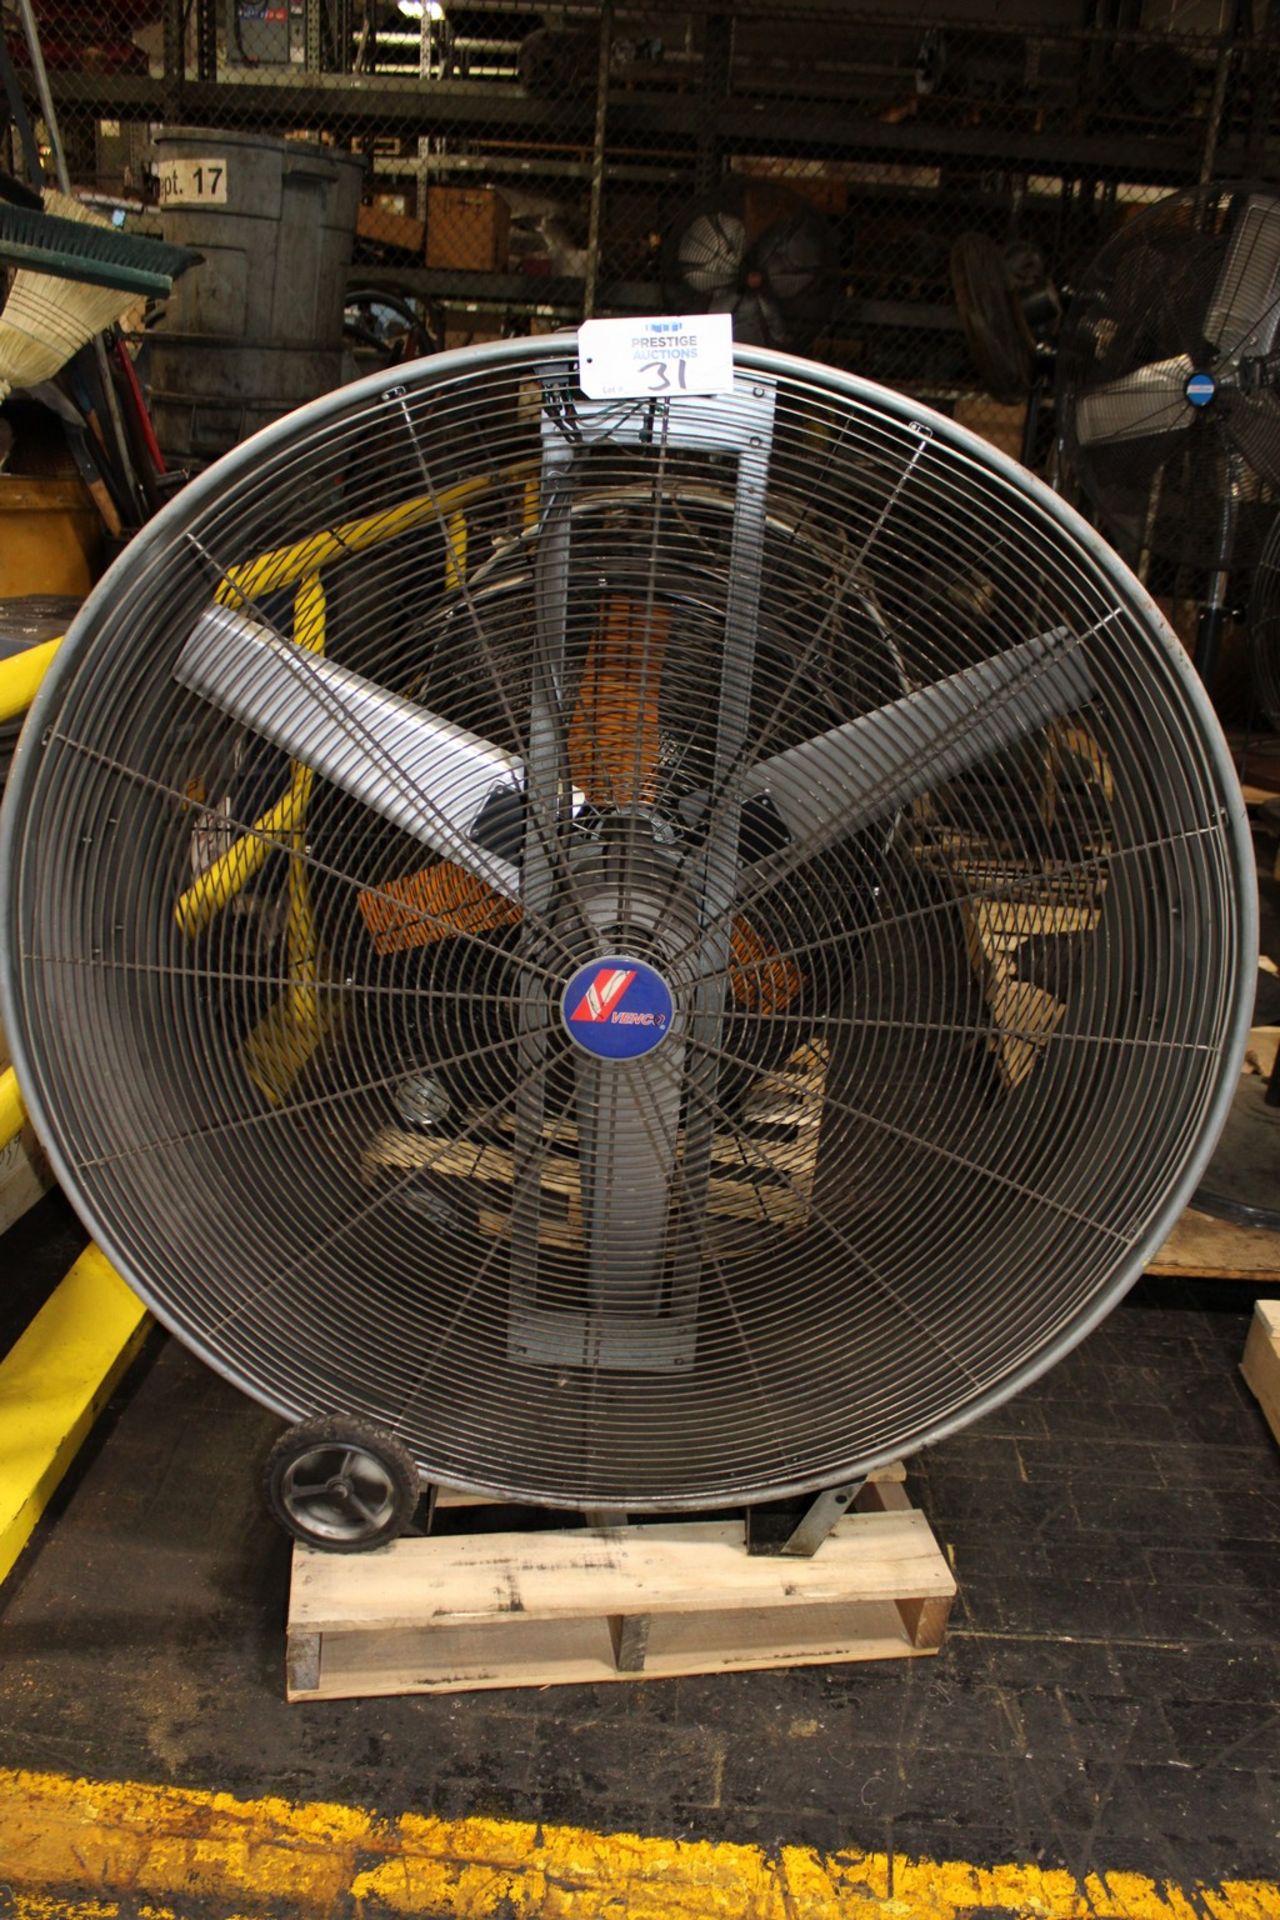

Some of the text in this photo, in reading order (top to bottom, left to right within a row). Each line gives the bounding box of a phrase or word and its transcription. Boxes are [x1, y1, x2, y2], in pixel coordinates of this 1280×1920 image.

[160, 167, 223, 202] pt. 17
[631, 335, 698, 348] PRESTIGE
[633, 348, 698, 360] AUCTIONS
[637, 359, 687, 392] 31
